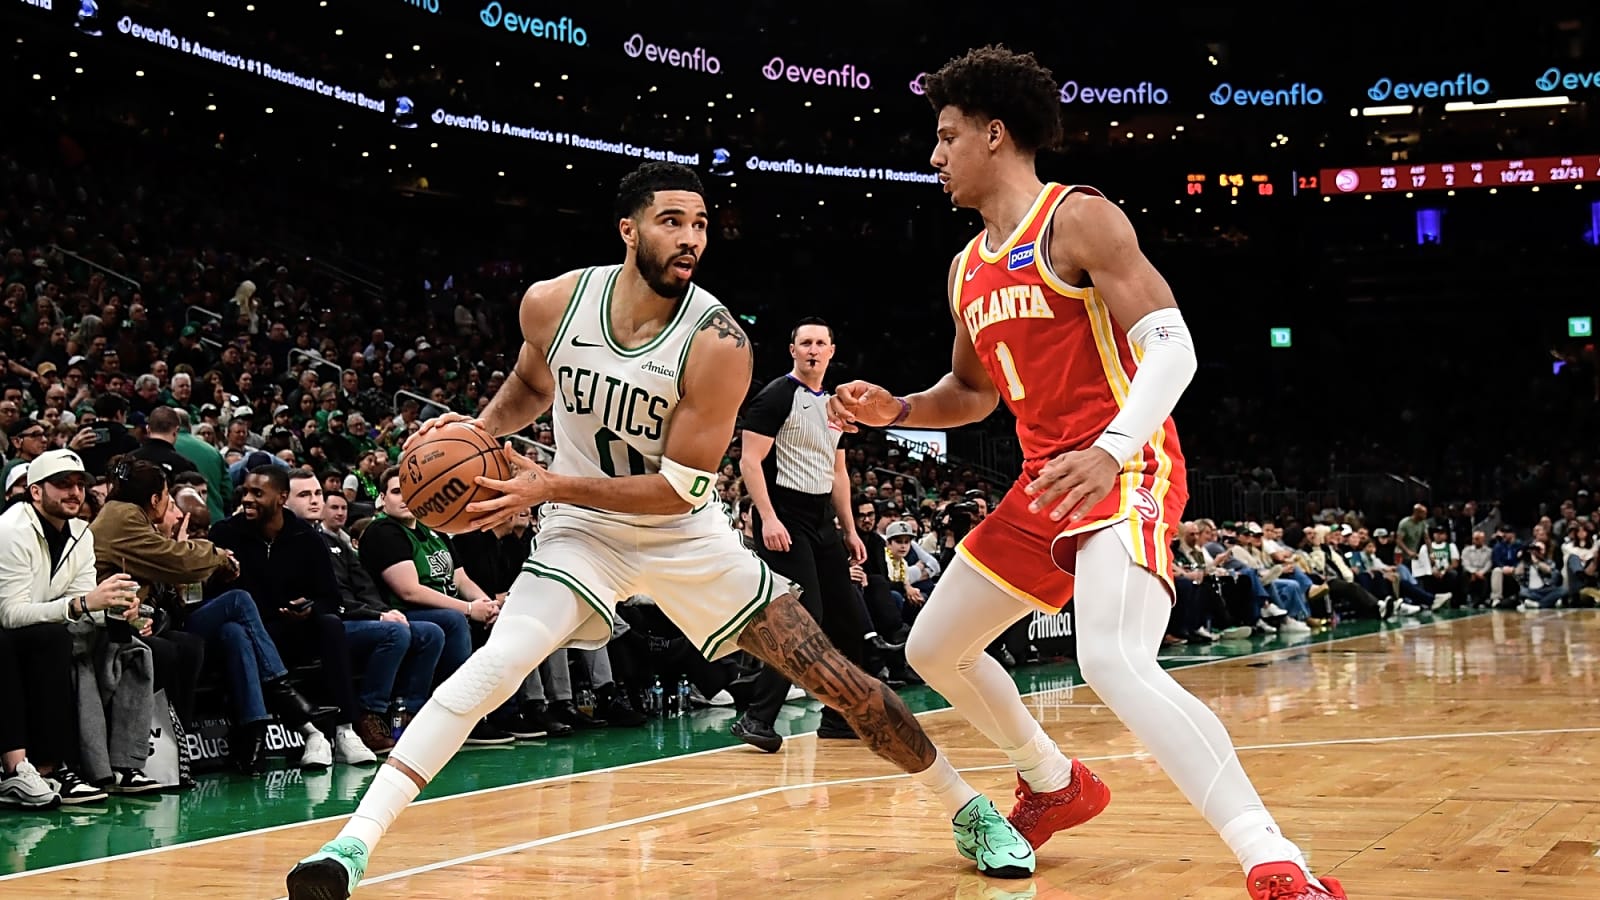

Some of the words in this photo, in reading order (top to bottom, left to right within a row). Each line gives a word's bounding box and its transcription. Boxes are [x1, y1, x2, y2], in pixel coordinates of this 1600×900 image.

[503, 12, 587, 46] evenflo
[131, 24, 179, 49] evenflo
[181, 37, 191, 52] is
[192, 42, 245, 69] America's
[263, 63, 315, 91] Rotational
[316, 80, 334, 96] Car
[334, 86, 356, 104] Seat
[357, 93, 385, 112] Brand
[645, 44, 720, 74] evenflo
[786, 64, 870, 89] evenflo
[1394, 73, 1489, 99] evenflo
[1080, 82, 1168, 104] evenflo
[1234, 83, 1323, 106] evenflo
[445, 114, 489, 131] evenflo
[491, 121, 501, 133] is
[502, 123, 554, 142] America's
[572, 134, 623, 154] Rotational
[624, 144, 642, 157] Car
[643, 147, 666, 161] Seat
[667, 151, 699, 165] Brand
[759, 159, 802, 173] evenflo
[804, 163, 815, 174] is
[816, 164, 868, 178] America's
[885, 169, 939, 184] Rotational
[1412, 175, 1426, 187] 17
[1445, 173, 1454, 186] 2
[1473, 172, 1483, 184] 4
[1500, 170, 1534, 183] 10/22
[963, 285, 1055, 345] ATLANTA
[641, 360, 675, 378] Amica
[994, 341, 1026, 401] 1
[558, 366, 669, 441] CELTICS
[412, 477, 471, 520] Wilson
[1028, 608, 1072, 641] Amica
